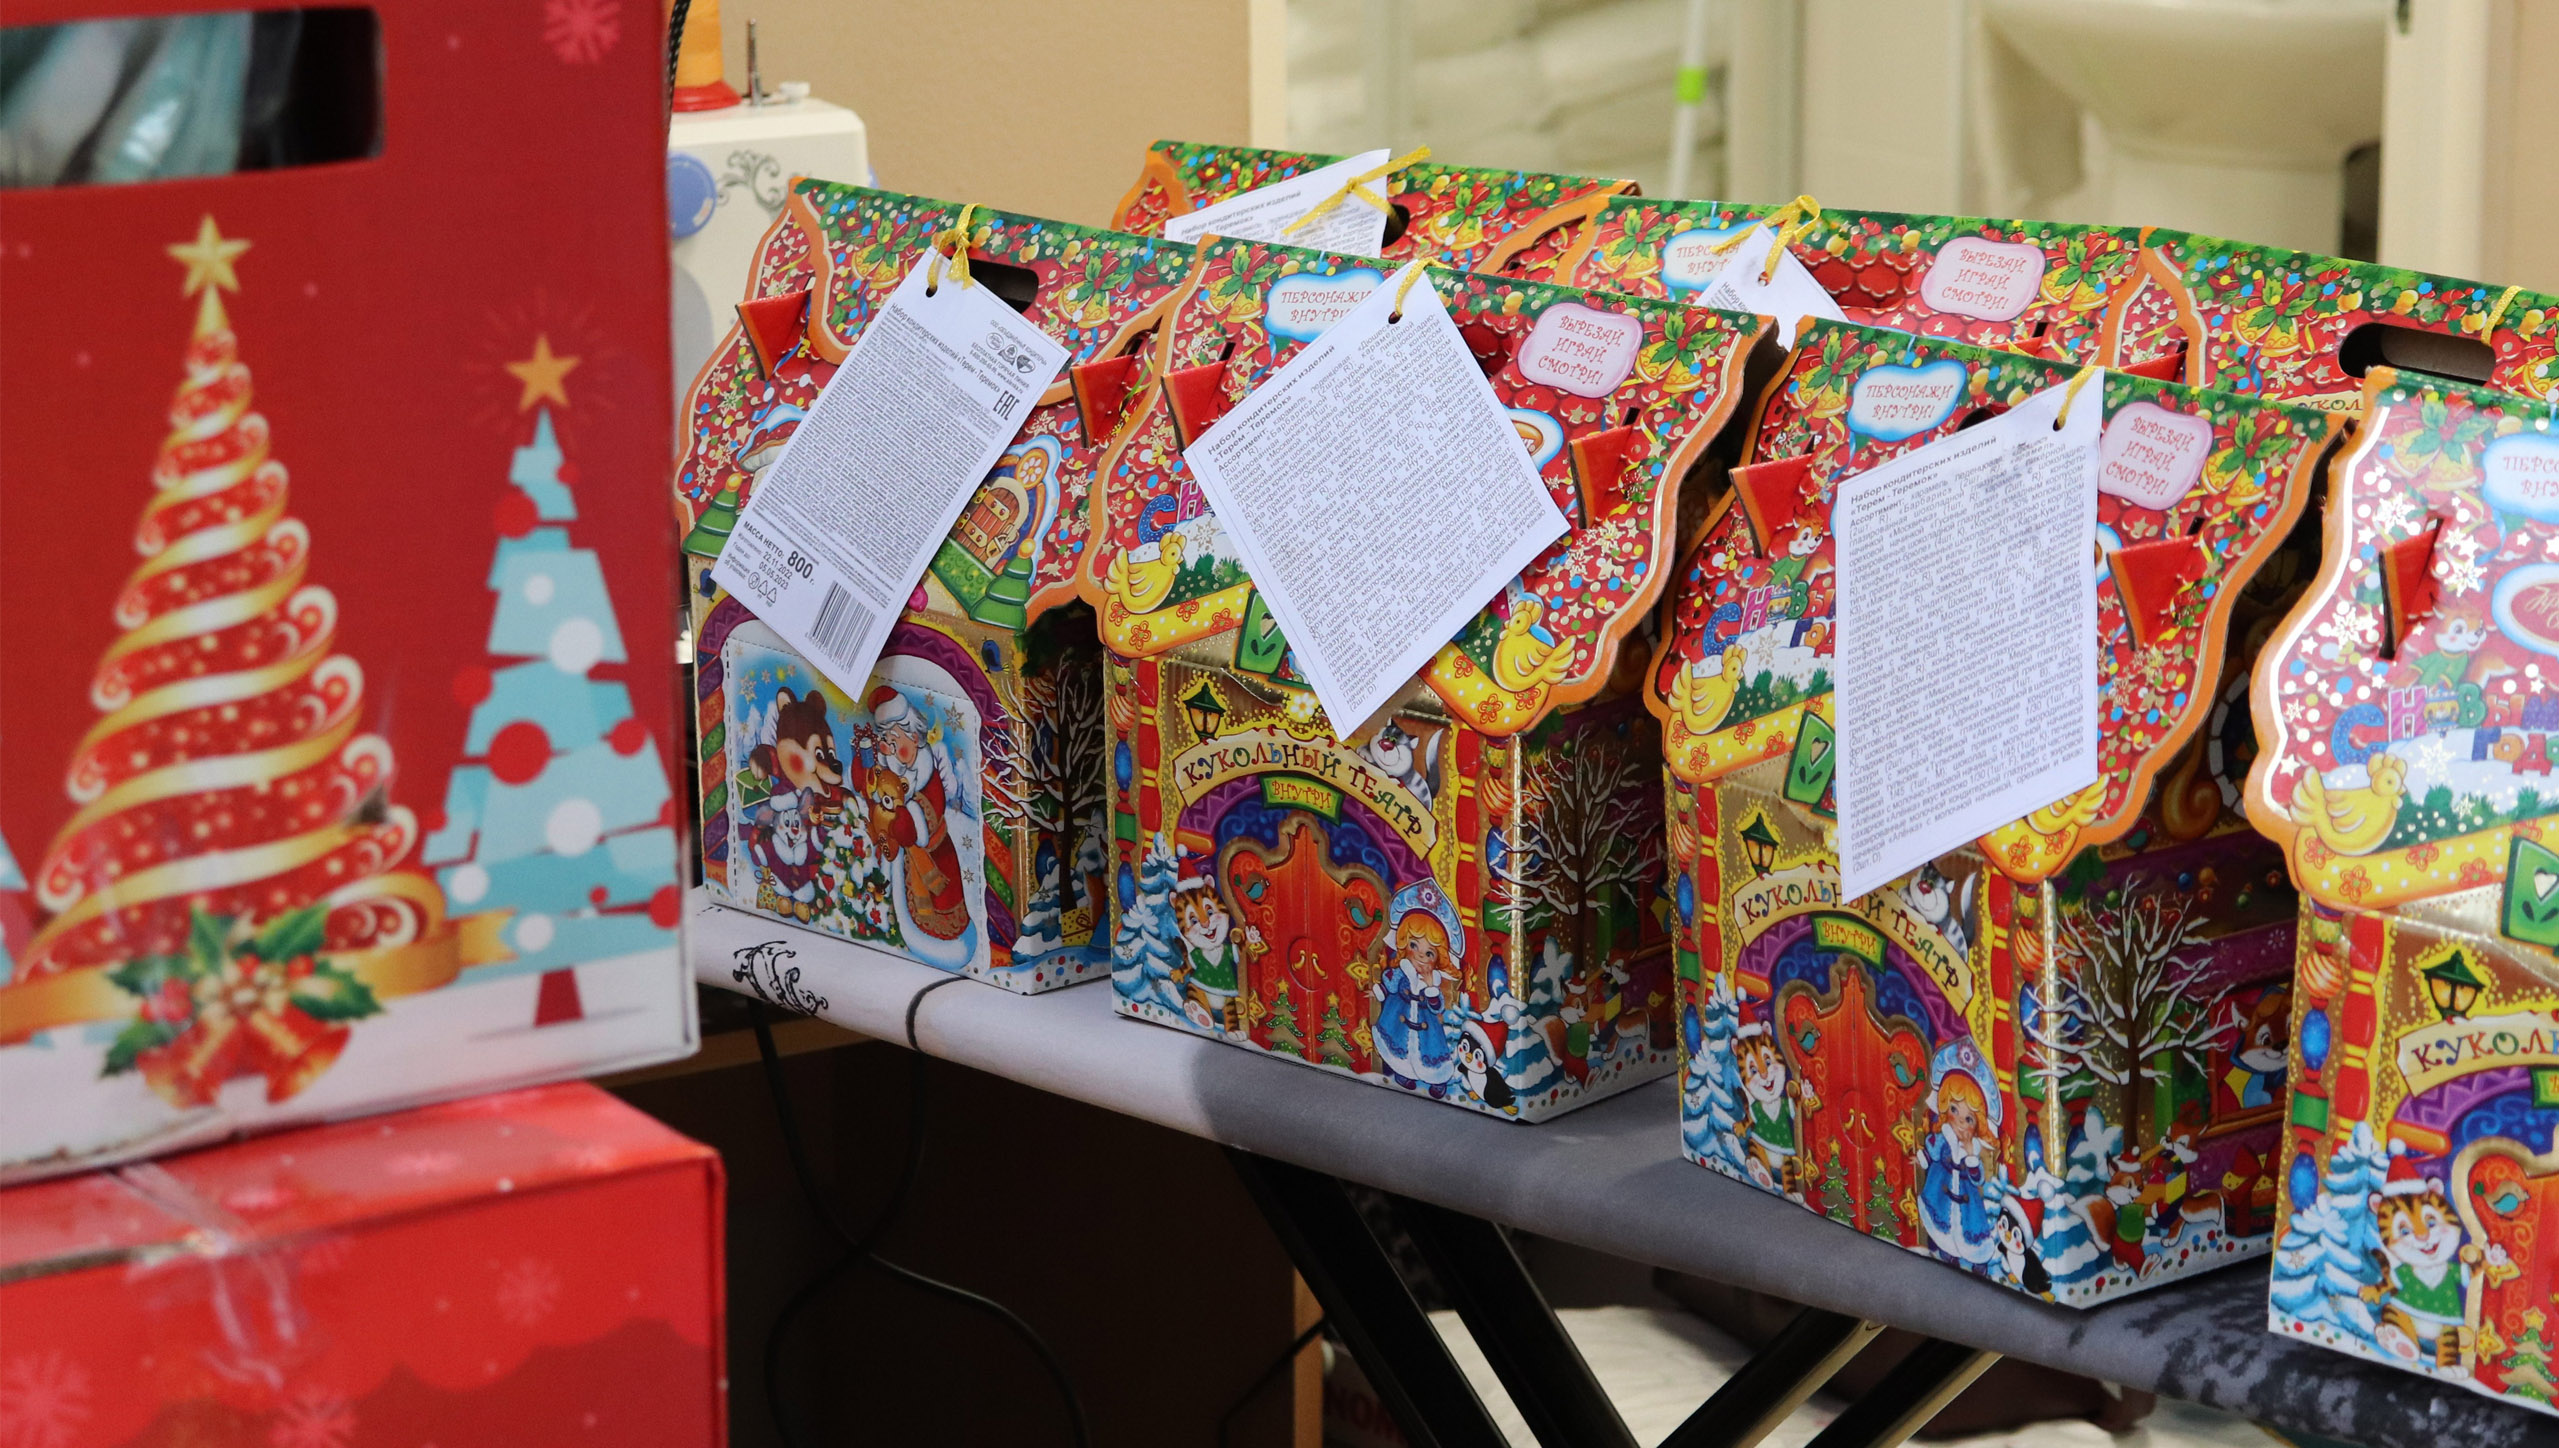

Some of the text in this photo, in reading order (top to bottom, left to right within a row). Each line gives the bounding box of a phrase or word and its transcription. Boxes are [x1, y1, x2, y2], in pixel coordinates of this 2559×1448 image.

[1954, 268, 2010, 290] ИГРАЙ
[1960, 248, 2027, 273] ВЫРЕЗАЙ
[1722, 282, 1739, 304] Набор
[1738, 300, 1752, 312] кон
[1942, 286, 2009, 310] СМОТРИ!
[889, 302, 908, 321] Набор
[905, 316, 939, 345] кондитерских
[936, 341, 959, 360] изделий
[956, 355, 976, 373] «Терем
[975, 369, 1000, 393] Теремок»
[1558, 315, 1624, 346] ВЫРЕЗАЙ
[1552, 337, 1607, 363] ИГРАЙ
[1265, 398, 1313, 441] «Барбарис»
[1360, 325, 1401, 358] карамель
[1538, 355, 1604, 385] СМОТРИ!
[1206, 344, 1335, 455] Набор кондитерских изделий
[1224, 437, 1280, 486] глазированная
[1282, 394, 1328, 437] шоколадной
[1330, 362, 1365, 395] глазурью
[1378, 320, 1415, 353] ликёрной
[1232, 468, 1267, 500] ореховой
[1269, 437, 1302, 469] начинкой
[1304, 405, 1338, 436] «Гусиные
[1341, 381, 1365, 405] лапки»
[1407, 318, 1440, 348] конфеты
[1866, 384, 1954, 400] ПЕРСОНАЖИ
[1213, 433, 1246, 463] «Терем
[1249, 395, 1291, 431] Теремок»
[1217, 427, 1269, 472] Ассортимент:
[1272, 395, 1306, 426] карамель
[1309, 354, 1351, 394] леденцовая:
[1228, 462, 1262, 493] начинкой
[1265, 422, 1308, 462] «Москвичка»
[1347, 358, 1383, 388] карамель
[1236, 459, 1289, 507] глазированные
[1289, 420, 1332, 461] шоколадной
[1331, 392, 1364, 425] глазурью
[1369, 355, 1408, 389] помадным
[1241, 485, 1270, 513] «Алёнка
[1346, 386, 1382, 419] «Коровка»
[1382, 371, 1400, 387] 30%
[1400, 348, 1428, 373] молока
[1872, 404, 1935, 420] ВНУТРИ!
[2130, 415, 2195, 453] ВЫРЕЗАЙ
[1850, 436, 1996, 505] Набор кондитерских изделий
[2121, 440, 2175, 472] ИГРАЙ
[1850, 495, 1885, 515] «Терем
[1892, 472, 1938, 497] Теремок»
[2106, 461, 2169, 496] СМОТРИ!
[1849, 497, 1904, 529] Ассортимент:
[1910, 479, 1948, 500] карамель
[1898, 486, 1952, 515] «Барбарис»
[743, 521, 763, 542] МАССА
[763, 535, 785, 559] НЕТТО:
[787, 550, 813, 578] 800
[763, 552, 793, 579] 22.11.2022
[758, 561, 789, 590] 05.05.2023
[1182, 742, 1422, 838] КУКОЛЬНЫЙ ТЕАТР
[1271, 780, 1332, 809] ВНУТРИ
[1822, 921, 1877, 955] ВНУТРИ
[1891, 906, 1959, 990] ТЕАТР
